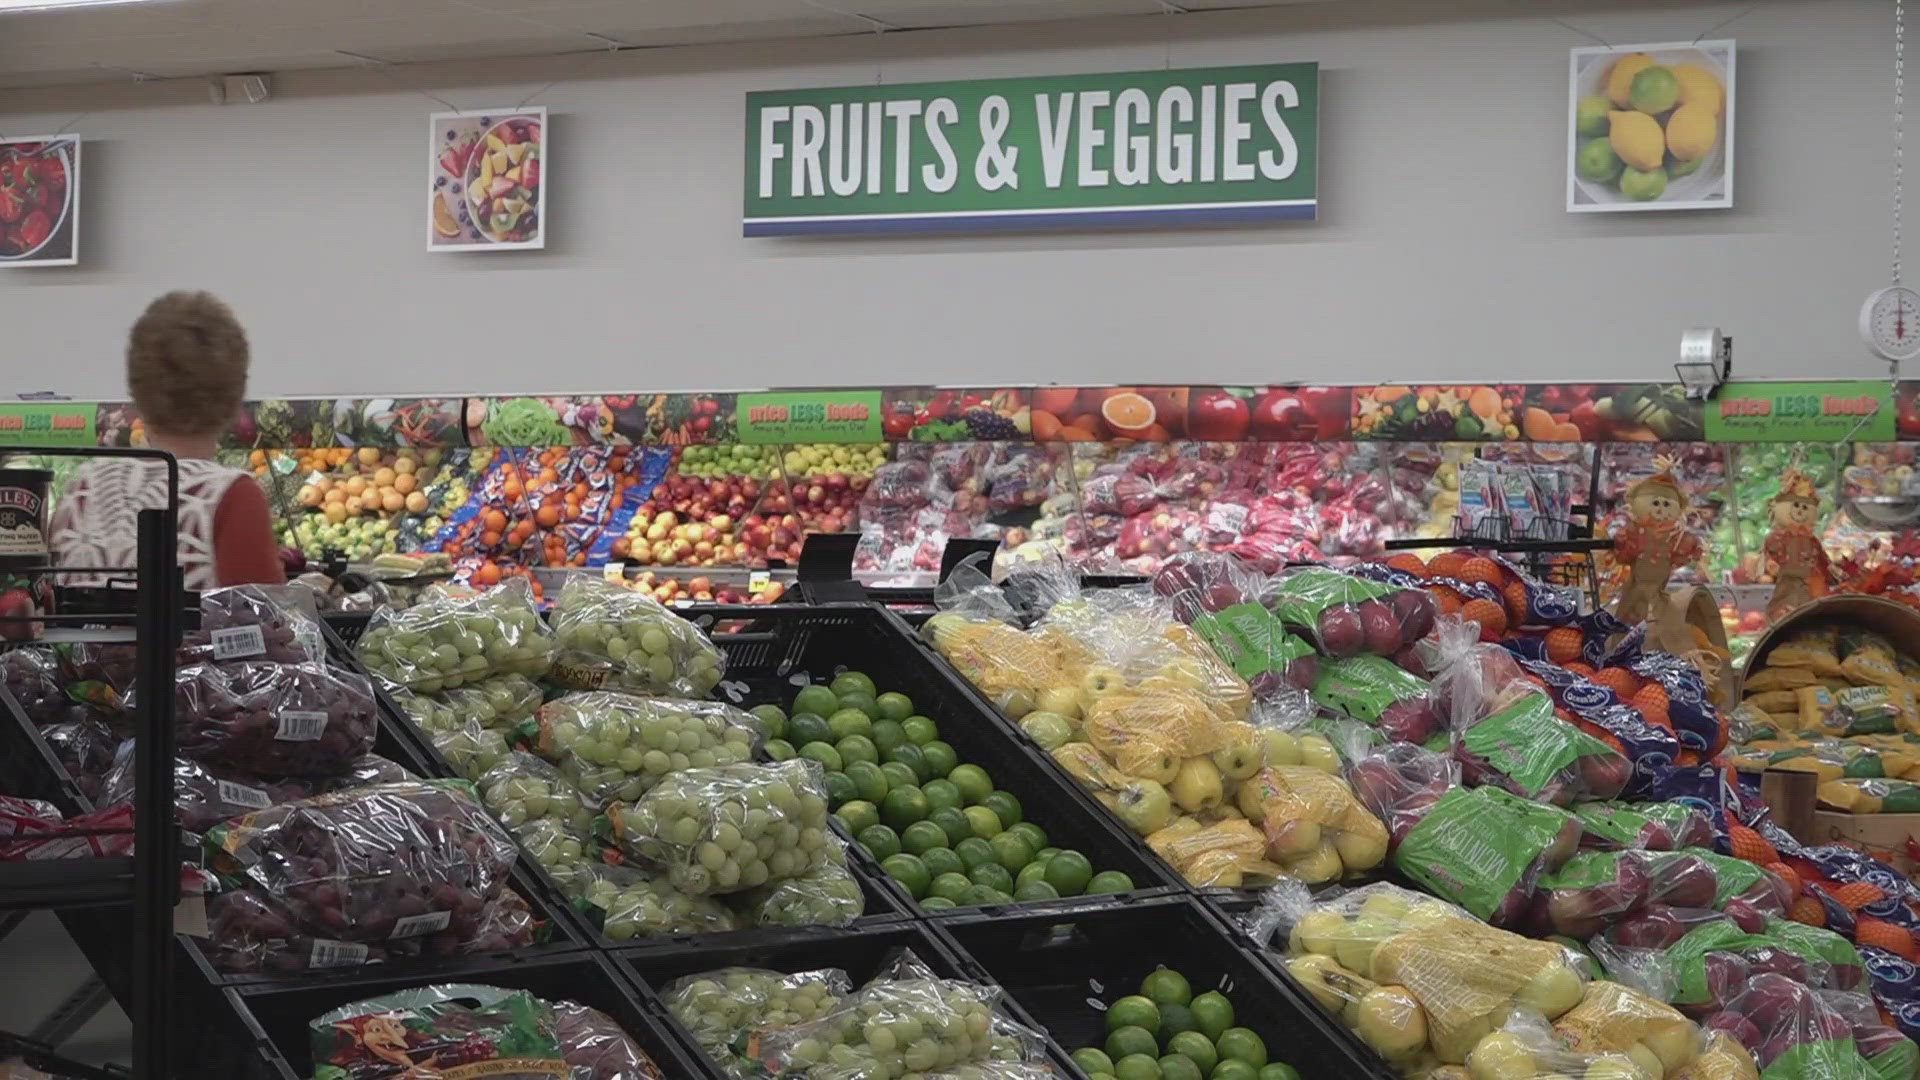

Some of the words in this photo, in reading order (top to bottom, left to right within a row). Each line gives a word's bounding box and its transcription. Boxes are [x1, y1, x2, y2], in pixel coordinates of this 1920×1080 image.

[758, 97, 959, 198] FRUITS
[974, 94, 1019, 192] &
[1035, 80, 1300, 188] VEGGIES
[0, 415, 23, 430] rice
[749, 404, 788, 425] price
[825, 403, 869, 422] foods
